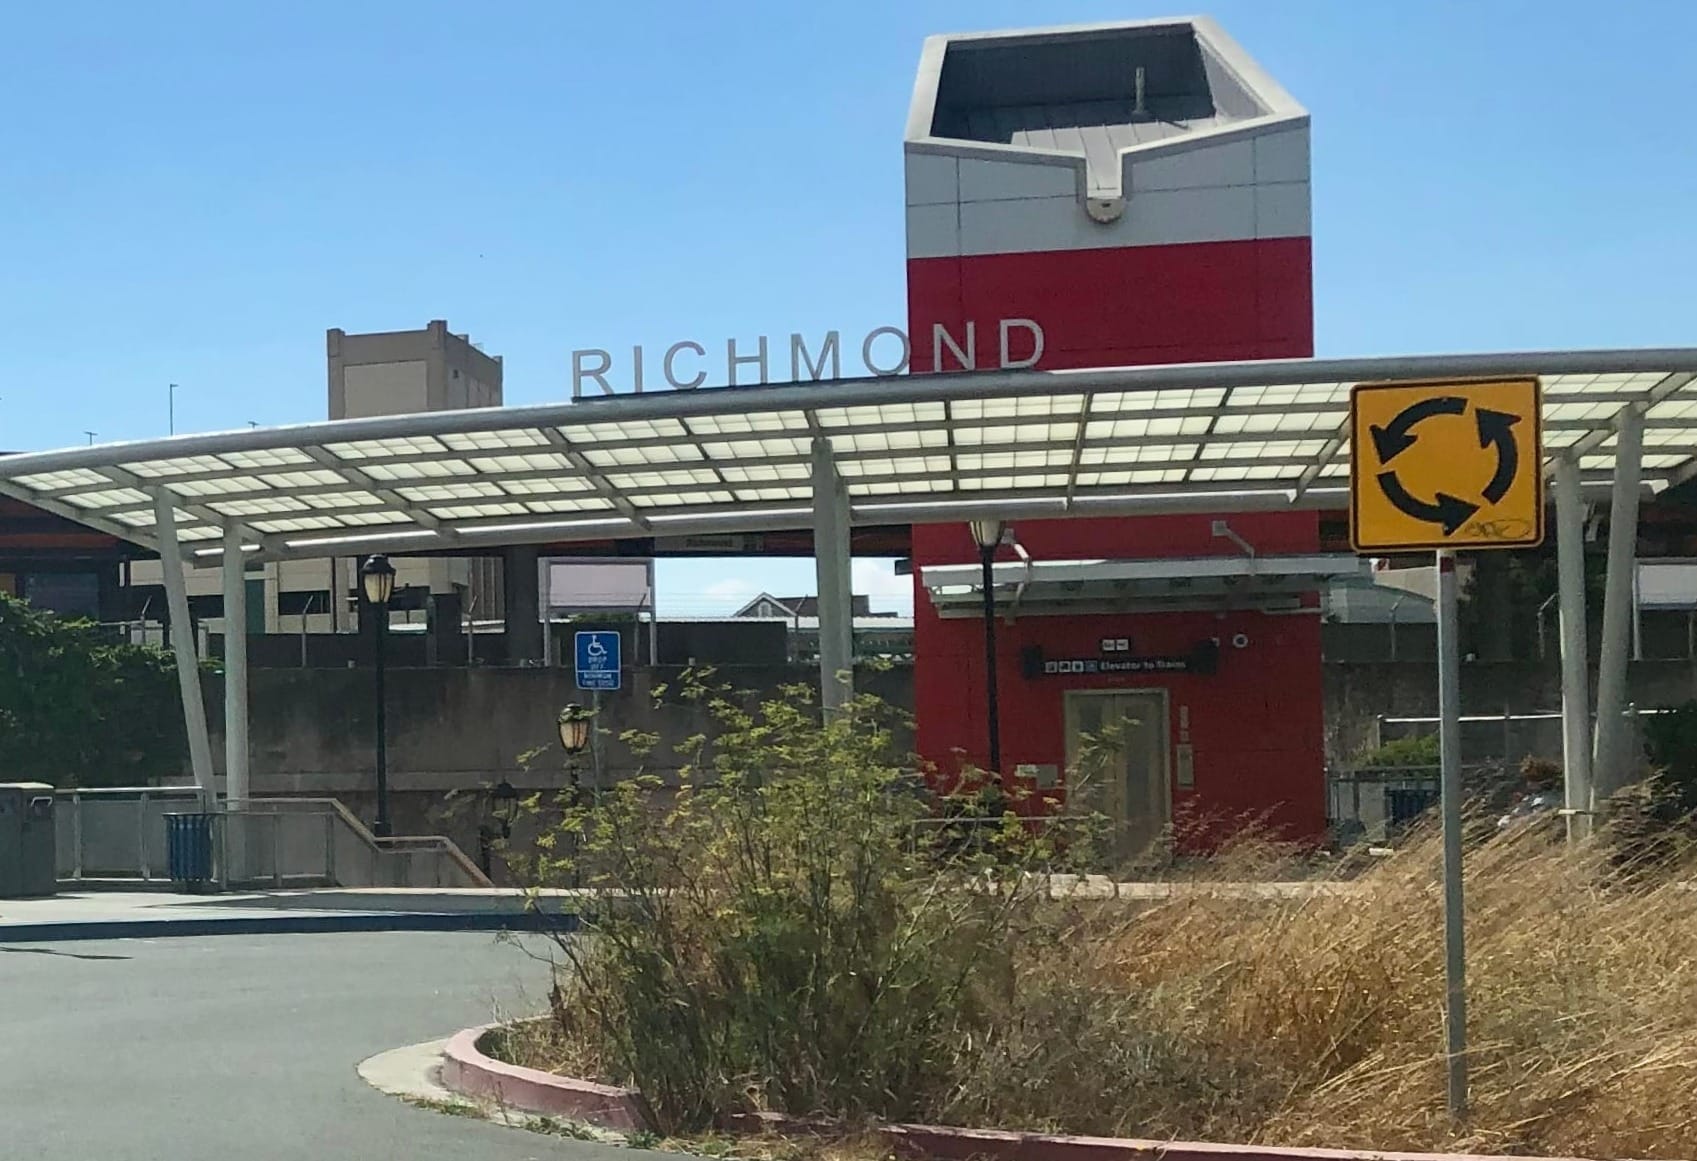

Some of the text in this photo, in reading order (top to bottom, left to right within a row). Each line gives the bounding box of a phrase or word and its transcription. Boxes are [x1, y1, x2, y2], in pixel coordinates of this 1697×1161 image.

[571, 318, 1045, 398] RICHMOND
[1100, 661, 1141, 671] Elevator
[1143, 661, 1155, 670] to
